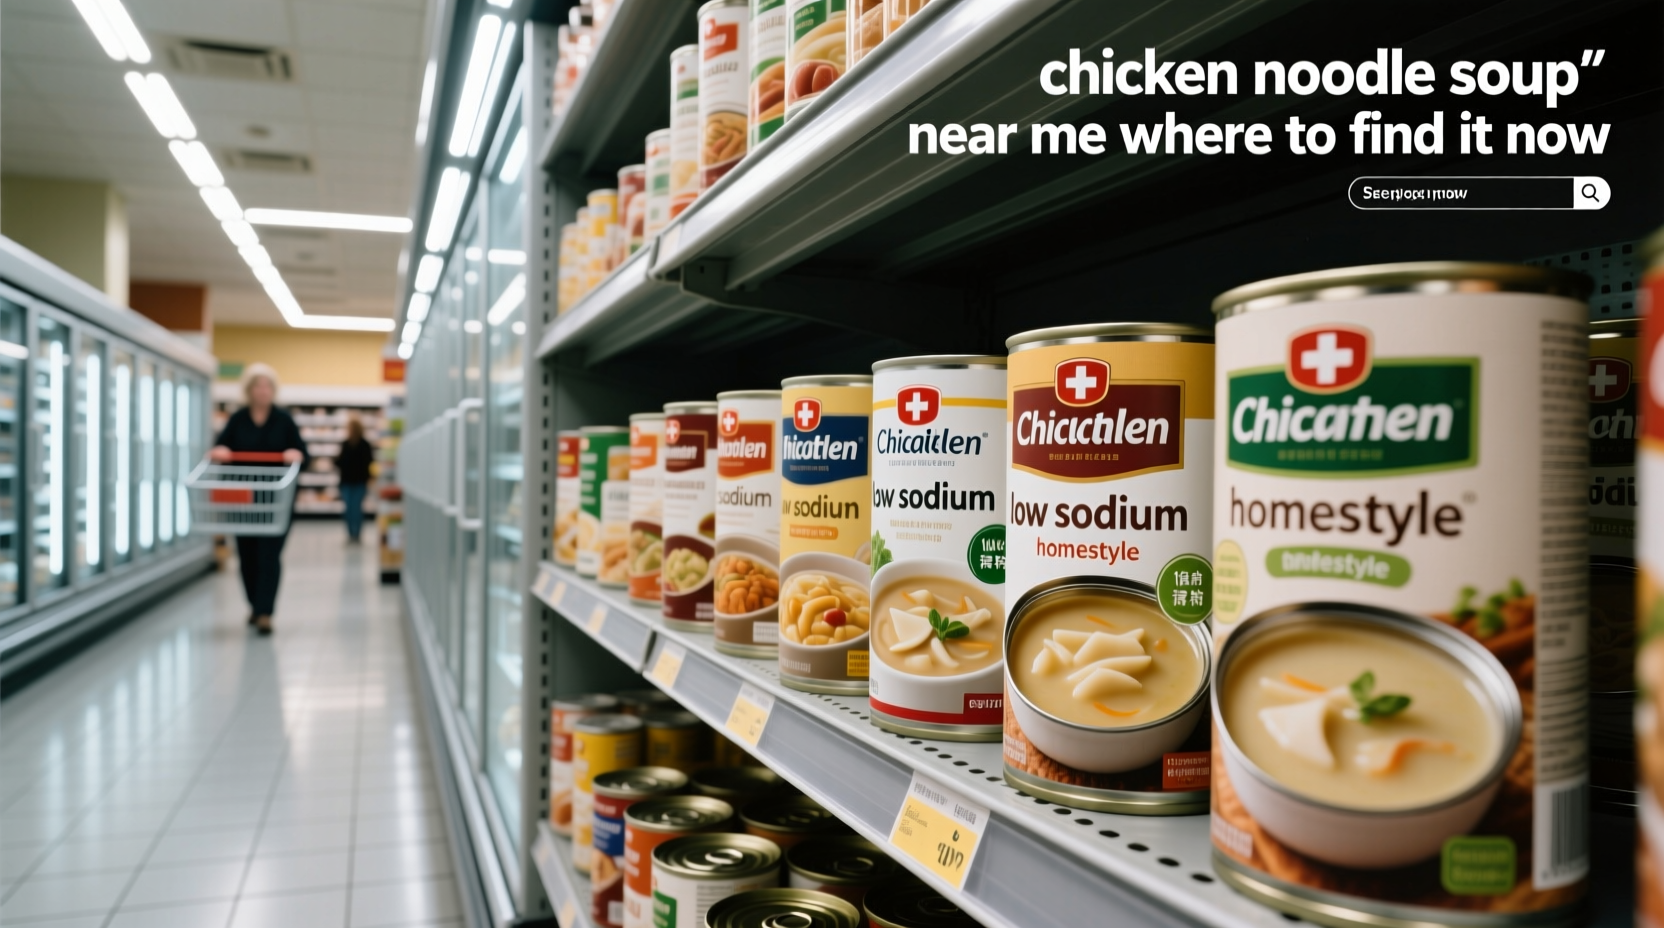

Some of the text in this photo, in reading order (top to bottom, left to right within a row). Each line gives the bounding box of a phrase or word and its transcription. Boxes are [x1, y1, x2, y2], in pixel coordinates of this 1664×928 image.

[898, 481, 996, 512] sodium
[1010, 490, 1188, 532] low sodium
[1229, 486, 1463, 548] homestyle
[1036, 536, 1141, 566] homestyle
